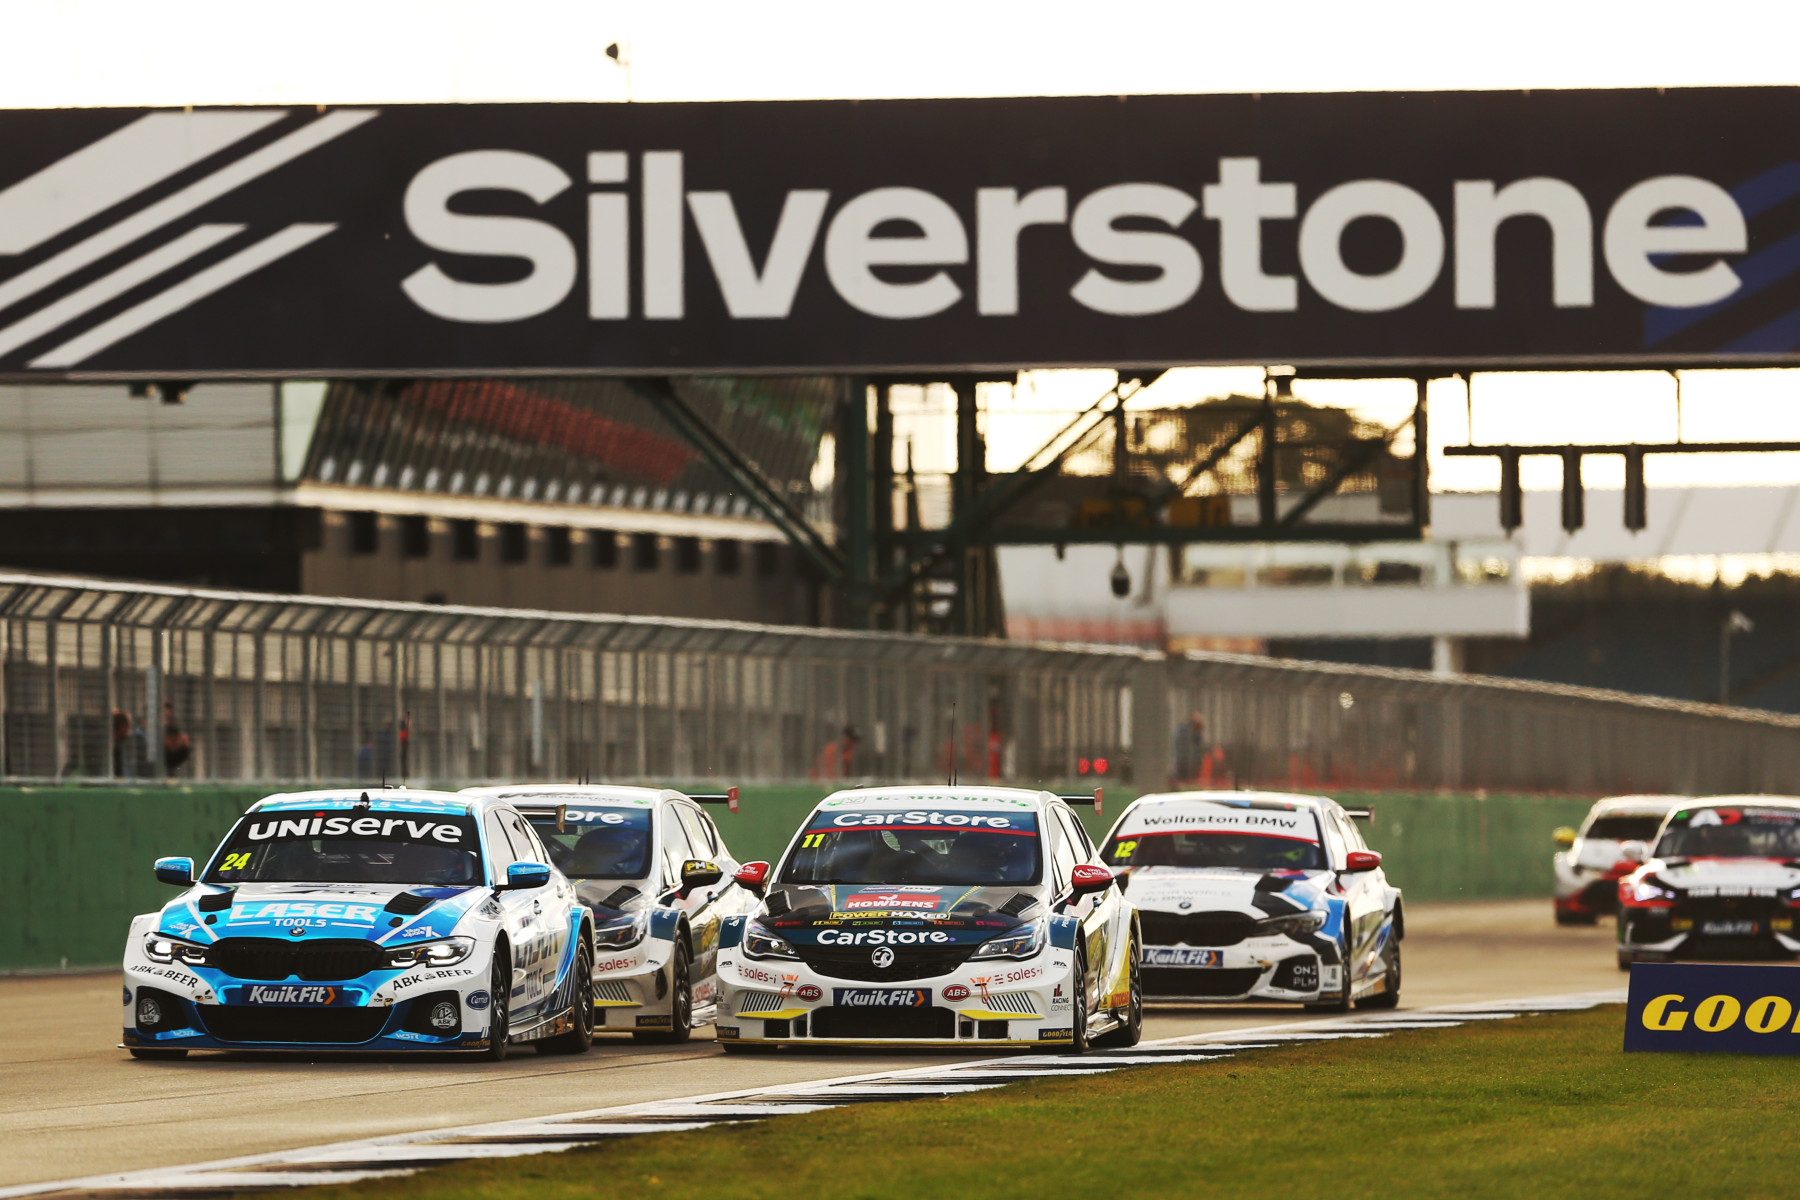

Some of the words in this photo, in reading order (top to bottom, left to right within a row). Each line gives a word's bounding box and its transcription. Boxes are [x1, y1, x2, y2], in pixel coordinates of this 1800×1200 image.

[402, 149, 1748, 323] Silverstone
[1144, 815, 1232, 826] Wollaston
[1245, 815, 1297, 829] BMW
[801, 833, 826, 849] 11
[1113, 840, 1138, 859] 12
[218, 852, 252, 871] 24
[229, 903, 377, 923] LASER
[847, 900, 934, 909] HOWDENS
[274, 918, 328, 928] TOOLS
[832, 911, 889, 919] POWER
[890, 910, 948, 920] MAXED
[598, 956, 637, 972] sales-i
[129, 965, 154, 974] ABK
[163, 970, 199, 988] BEER
[392, 974, 424, 991] ABK
[435, 969, 475, 980] BEER
[744, 967, 777, 984] sales-i
[1006, 965, 1043, 983] sales-i
[800, 990, 820, 998] ABS
[945, 989, 968, 999] ABS
[1641, 993, 1800, 1034] GOO
